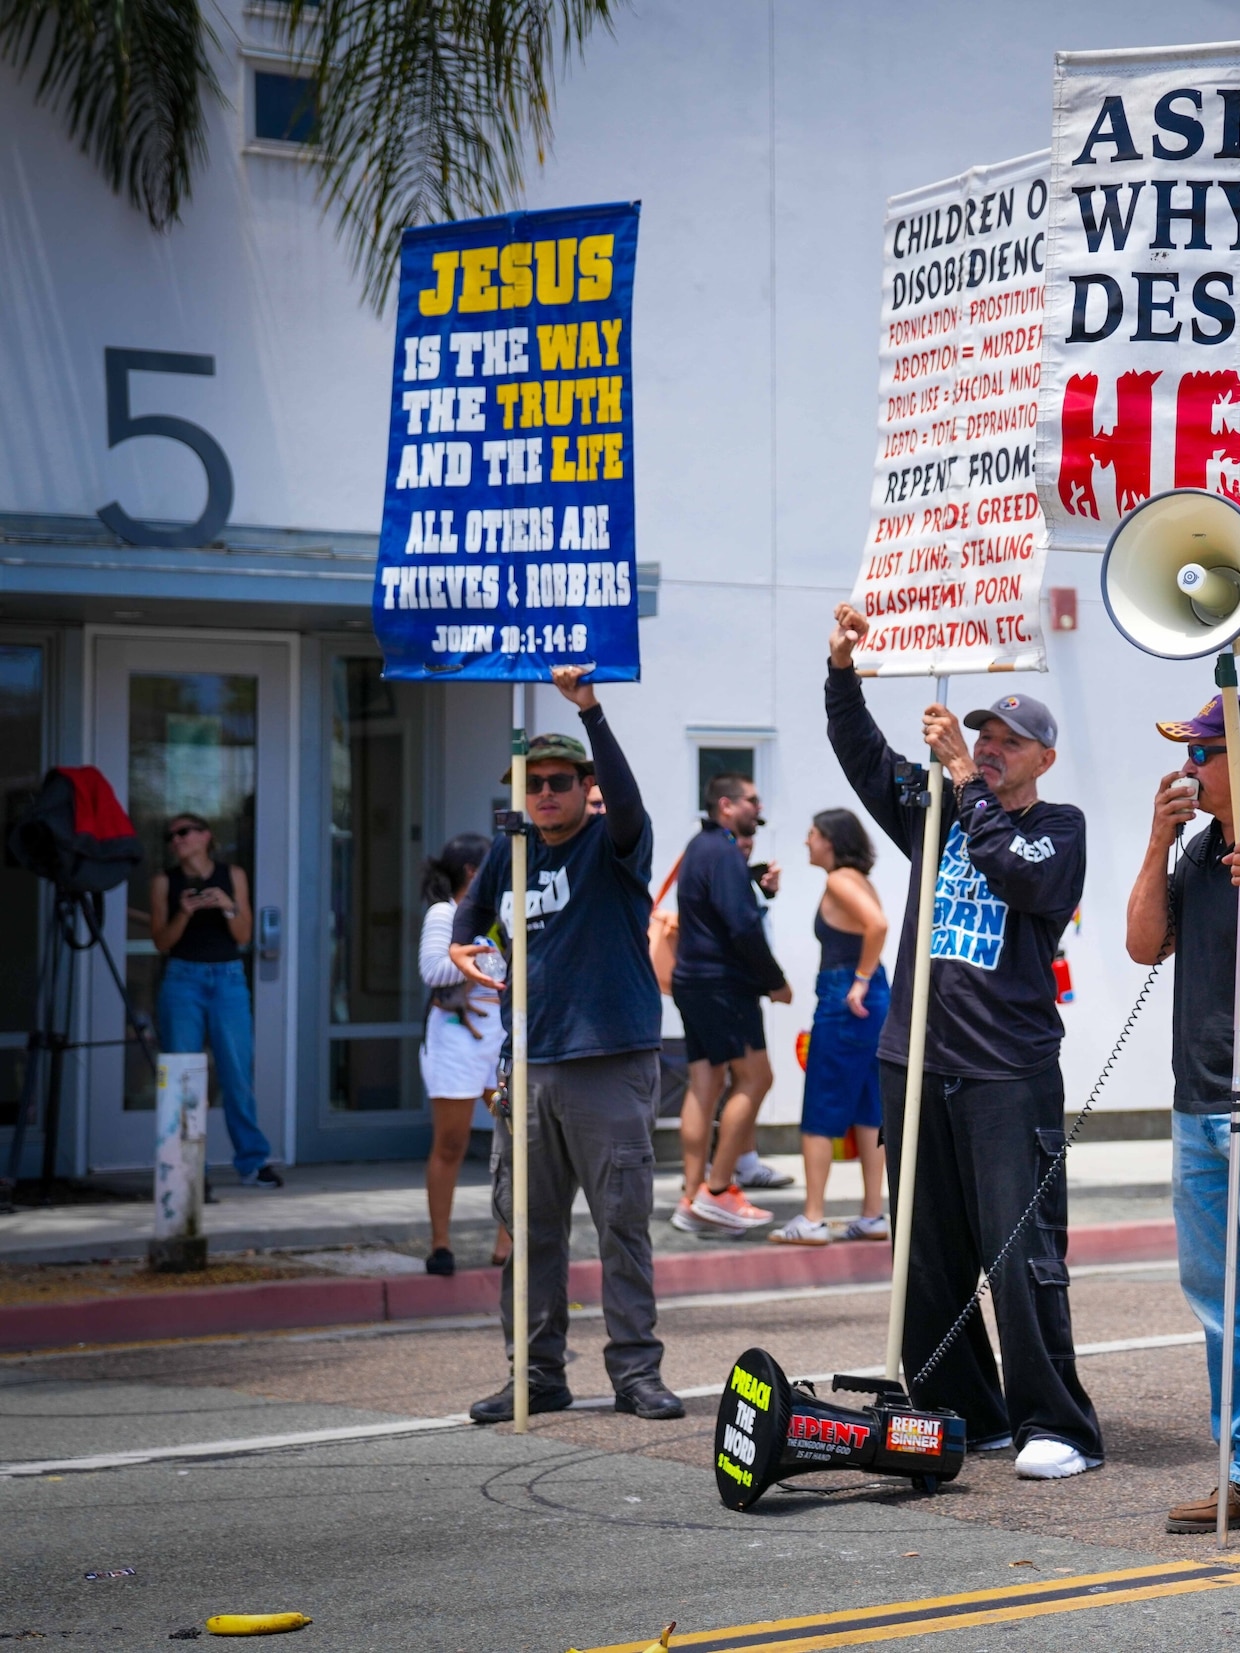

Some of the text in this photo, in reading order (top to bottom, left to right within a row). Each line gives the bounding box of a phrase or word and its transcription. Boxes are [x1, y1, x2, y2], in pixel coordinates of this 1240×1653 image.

[894, 187, 1015, 259] CHILDREN
[419, 234, 614, 316] JESUS
[404, 319, 622, 381] IS THE WAY
[893, 345, 958, 383] ABORTION
[403, 376, 622, 435] THE TRUTH
[887, 392, 916, 421] DRUG
[920, 385, 940, 413] USE
[97, 346, 235, 548] 5
[396, 433, 623, 490] AND THE LIFE
[884, 428, 918, 458] LGBTQ
[884, 456, 957, 504] REPENT
[405, 510, 458, 554] ALL
[561, 505, 609, 550] ARE
[381, 566, 499, 609] THIEVES
[525, 561, 630, 607] ROBBERS
[432, 624, 587, 653] JOHN 10:1-14:6
[996, 614, 1032, 644] ETC.
[731, 1365, 772, 1411] PREACH
[735, 1399, 756, 1435] THE
[891, 1416, 941, 1436] REPENT
[723, 1424, 756, 1466] WORD
[804, 1451, 814, 1459] AT
[826, 1443, 835, 1452] OF
[835, 1445, 851, 1455] GOD
[891, 1432, 939, 1449] SINNER
